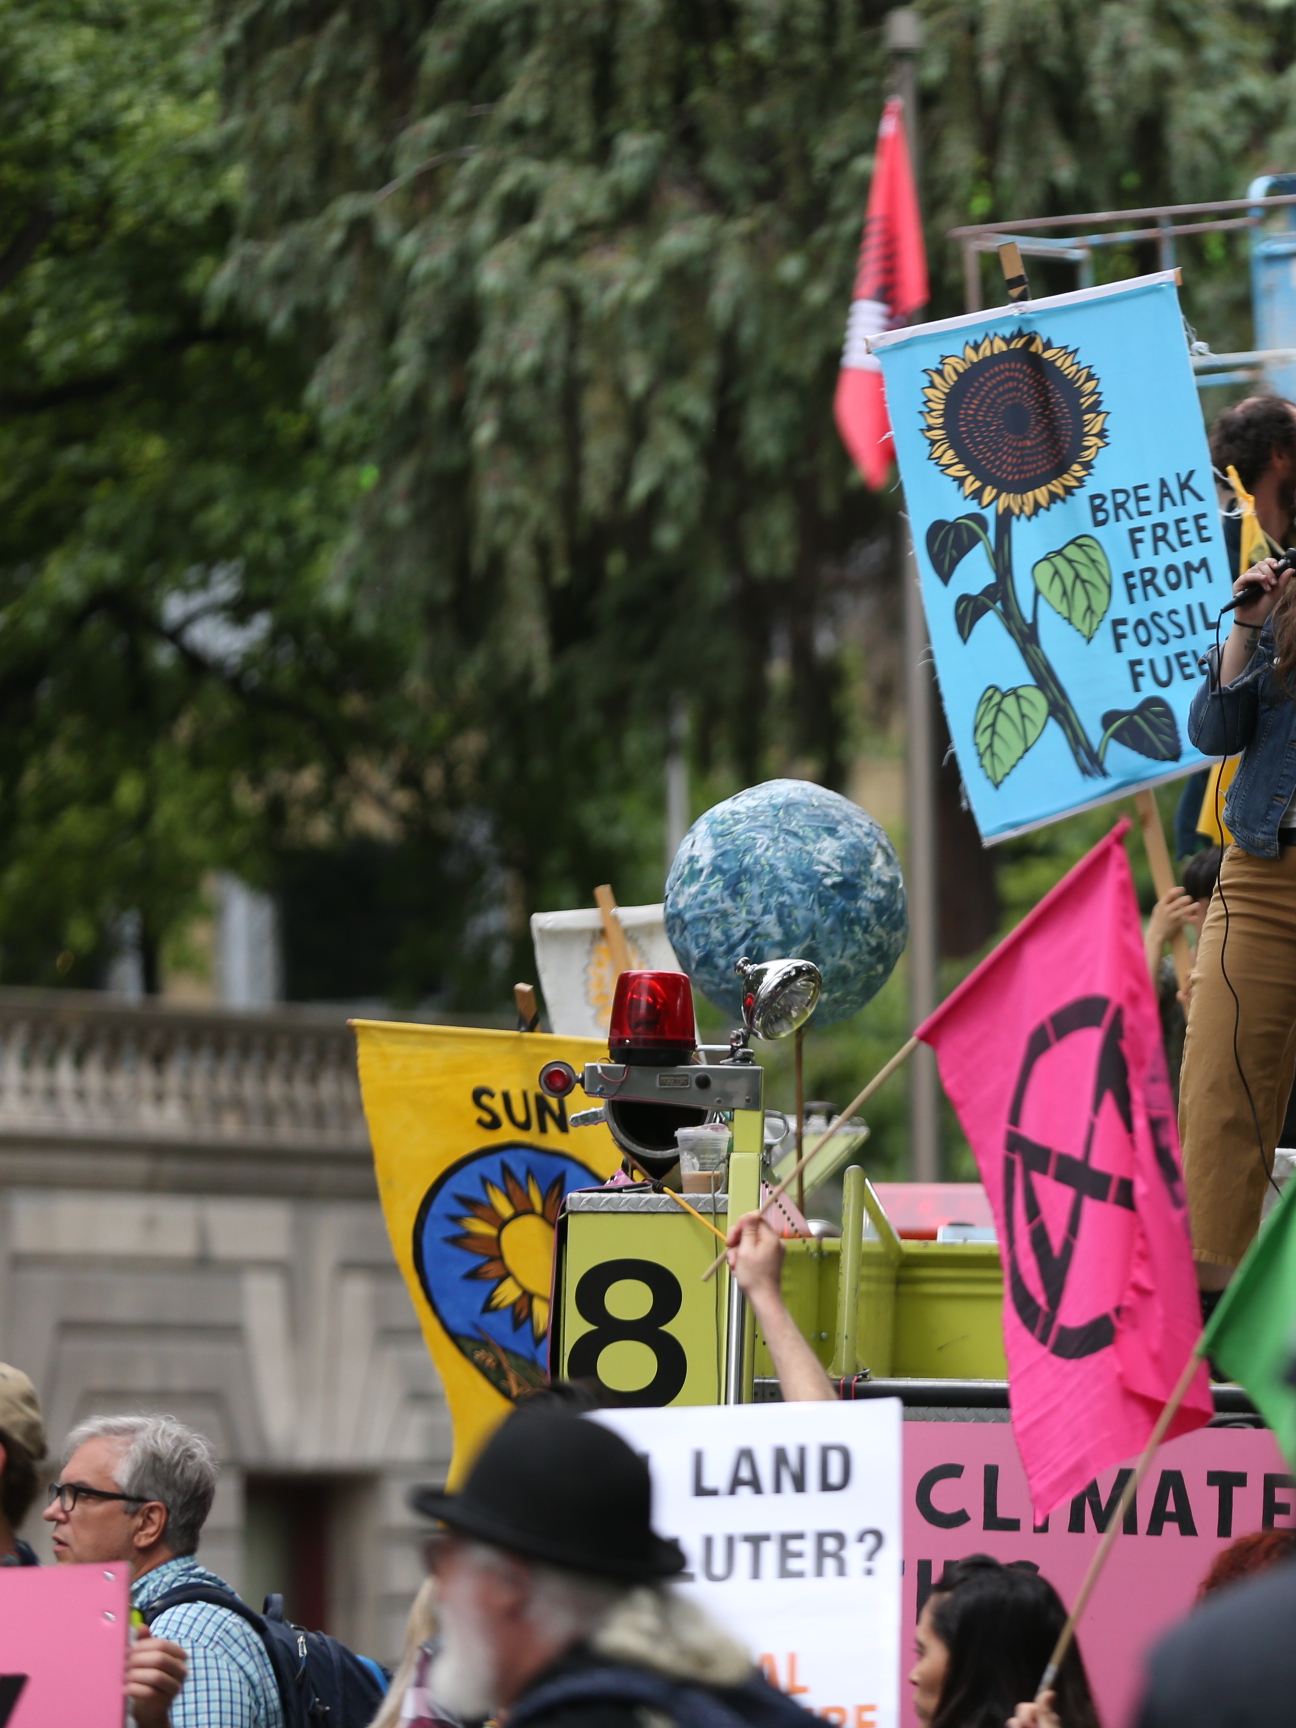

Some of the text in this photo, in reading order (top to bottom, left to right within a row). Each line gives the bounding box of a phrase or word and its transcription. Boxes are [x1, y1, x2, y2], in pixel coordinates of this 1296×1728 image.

[1088, 469, 1205, 528] BREAK
[1128, 512, 1213, 560] FREE
[1122, 556, 1213, 605] FROM
[1111, 601, 1219, 653] FOSSIL
[1128, 643, 1214, 692] FUEL
[472, 1085, 569, 1135] SUN
[567, 1258, 688, 1409] 8
[693, 1444, 852, 1497] LAND
